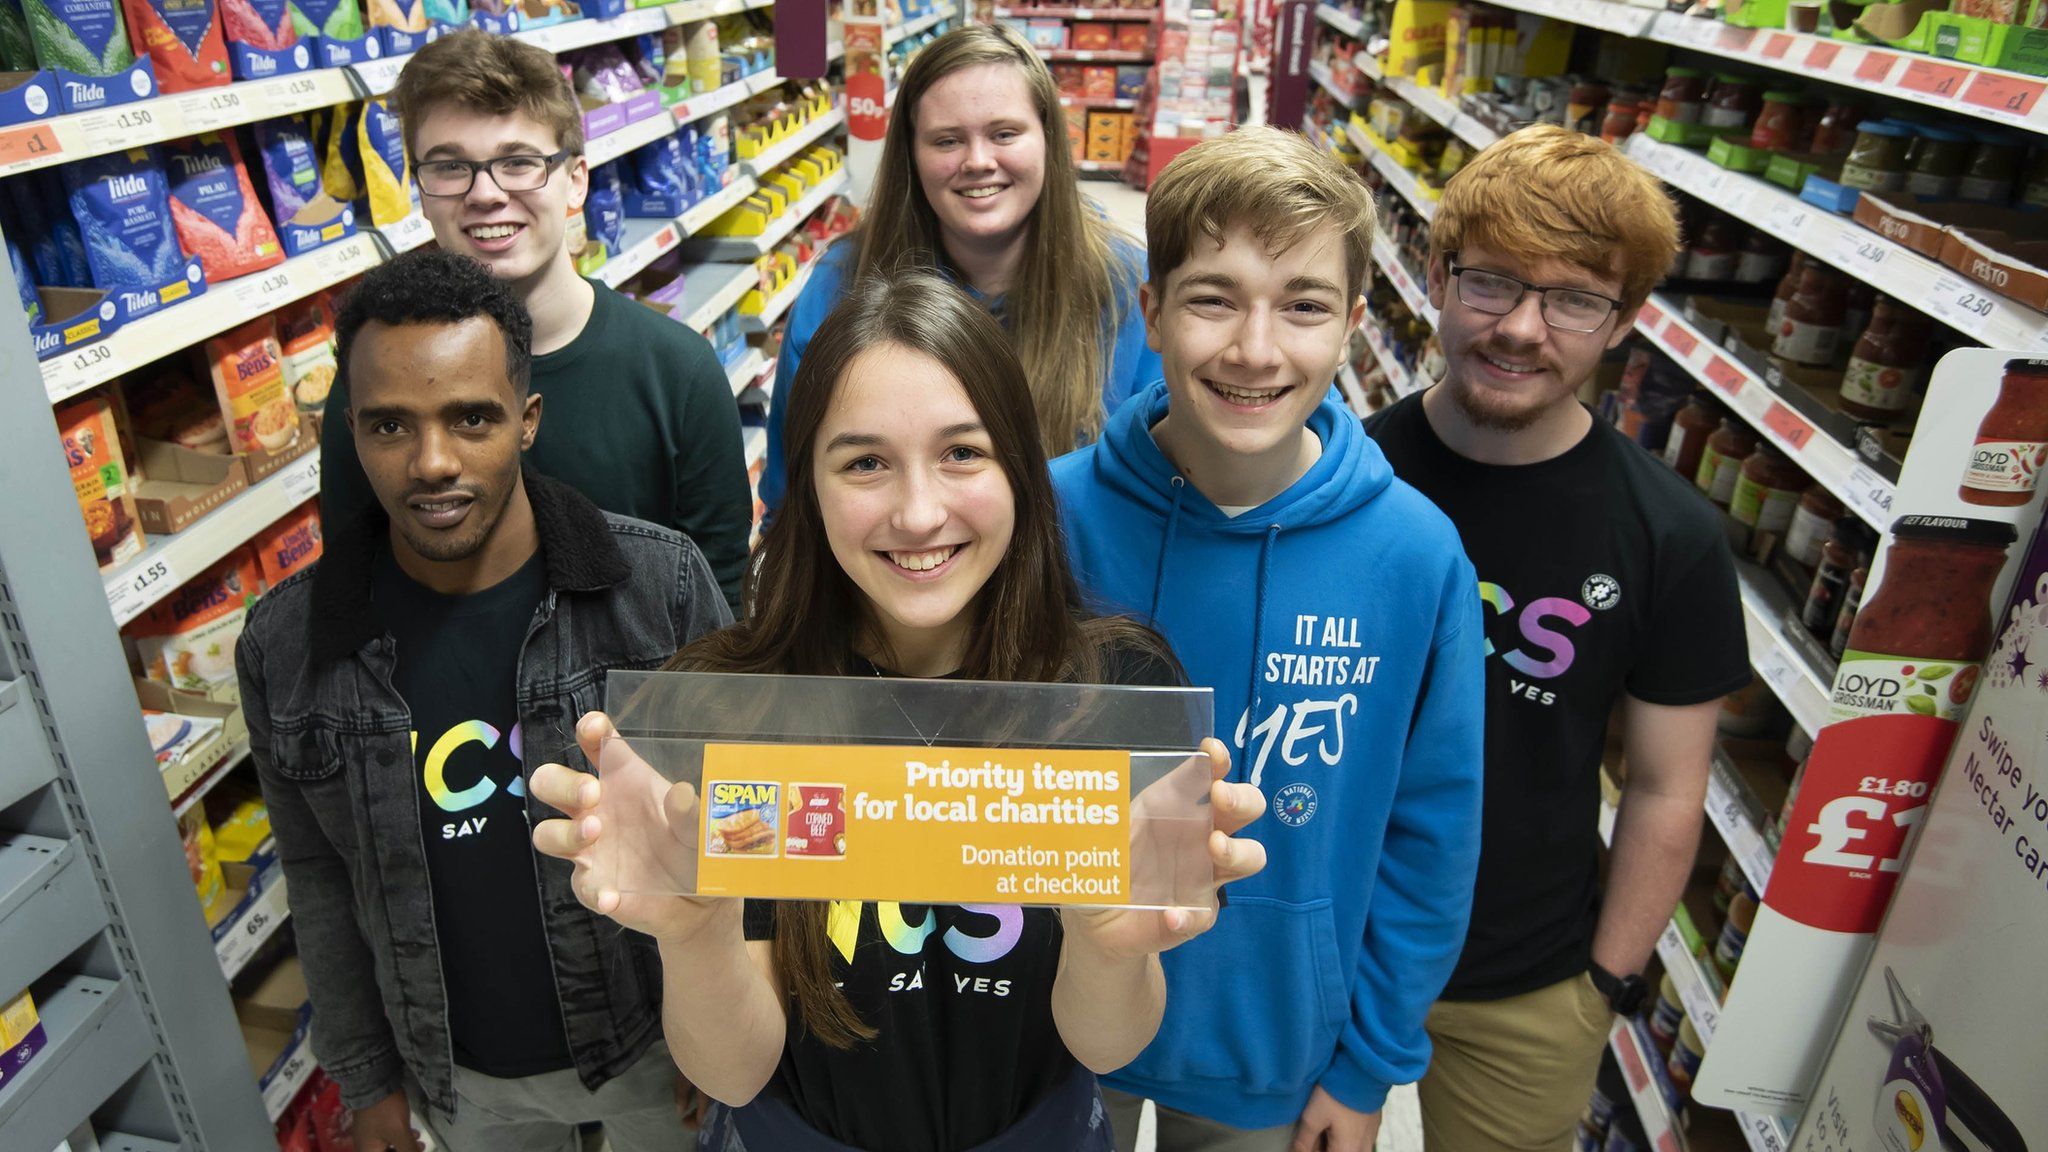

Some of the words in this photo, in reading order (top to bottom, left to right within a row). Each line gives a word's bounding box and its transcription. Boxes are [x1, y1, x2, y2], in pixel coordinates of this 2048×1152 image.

[246, 52, 277, 73] Tilda
[65, 81, 105, 103] Tilda
[210, 93, 240, 110] £1.50
[2007, 92, 2028, 110] £1
[117, 110, 152, 129] £1.50
[850, 97, 884, 119] 50p
[27, 133, 47, 153] £1
[172, 154, 223, 175] Tilda
[99, 174, 147, 199] Tilda
[262, 274, 288, 294] £1.30
[1972, 258, 2009, 288] PESTO
[120, 290, 157, 313] Tilda
[1957, 293, 1995, 317] £2.50
[74, 345, 111, 370] £1.30
[1973, 449, 2009, 465] LOYD
[177, 480, 243, 524] WHOLEGRAIN
[1903, 515, 1919, 525] GET
[1919, 516, 1969, 529] FLAVOUR
[134, 561, 167, 593] £1.55
[1295, 615, 1318, 645] IT
[1321, 617, 1362, 648] ALL
[1265, 653, 1350, 685] STARTS
[1351, 656, 1380, 684] AT
[1510, 679, 1557, 705] YES
[1838, 673, 1900, 697] LOYD
[1834, 691, 1895, 711] GROSSMAN
[1234, 693, 1358, 787] YES
[184, 737, 232, 783] CLASSIC
[905, 760, 1025, 796] Priority
[1032, 762, 1120, 791] items
[1979, 716, 2022, 788] Swipe
[2022, 783, 2048, 832] yo
[714, 784, 777, 805] SPAM
[1858, 776, 1928, 798] £1.80
[806, 812, 833, 825] CORNED
[853, 792, 898, 820] for
[904, 794, 977, 822] local
[984, 796, 1119, 825] charities
[442, 817, 487, 839] SAY
[810, 824, 827, 837] BEEF
[1964, 752, 2015, 834] Nectar
[2015, 835, 2048, 892] car
[961, 844, 1059, 867] Donation
[1065, 847, 1121, 871] point
[995, 874, 1018, 893] at
[1023, 872, 1121, 895] checkout
[247, 913, 269, 935] 65p
[953, 973, 1012, 997] YES
